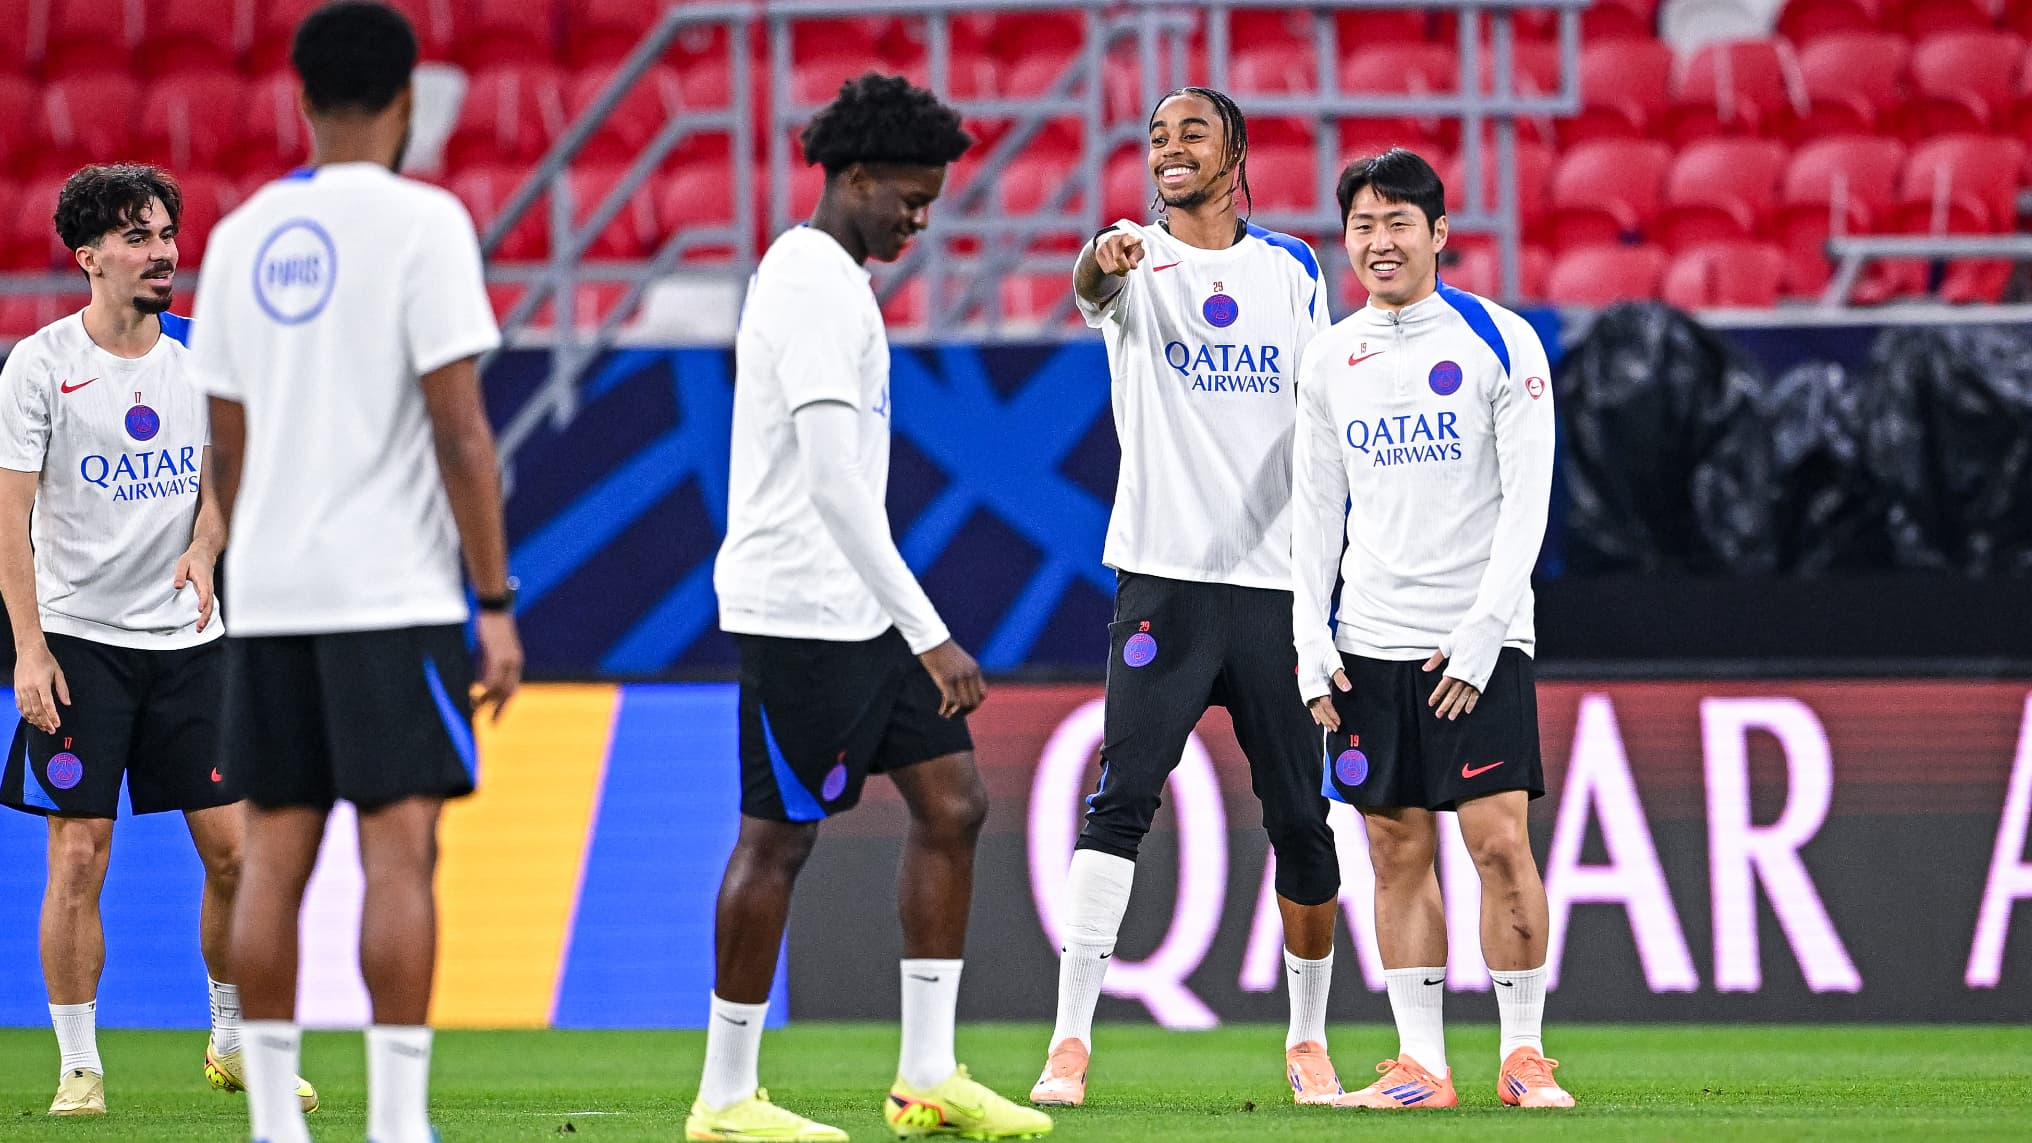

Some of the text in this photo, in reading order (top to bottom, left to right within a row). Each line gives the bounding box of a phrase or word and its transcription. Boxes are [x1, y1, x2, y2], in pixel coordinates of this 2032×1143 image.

[1213, 281, 1224, 292] 29
[1165, 341, 1280, 376] QATAR
[1192, 374, 1280, 394] AIRWAYS
[134, 391, 142, 404] 17
[1346, 411, 1461, 454] QATAR
[1373, 442, 1462, 467] AIRWAYS
[80, 446, 197, 489] QATAR
[112, 475, 199, 502] AIRWAYS
[1138, 620, 1150, 632] 29
[64, 737, 73, 750] 17
[1350, 734, 1360, 747] 19
